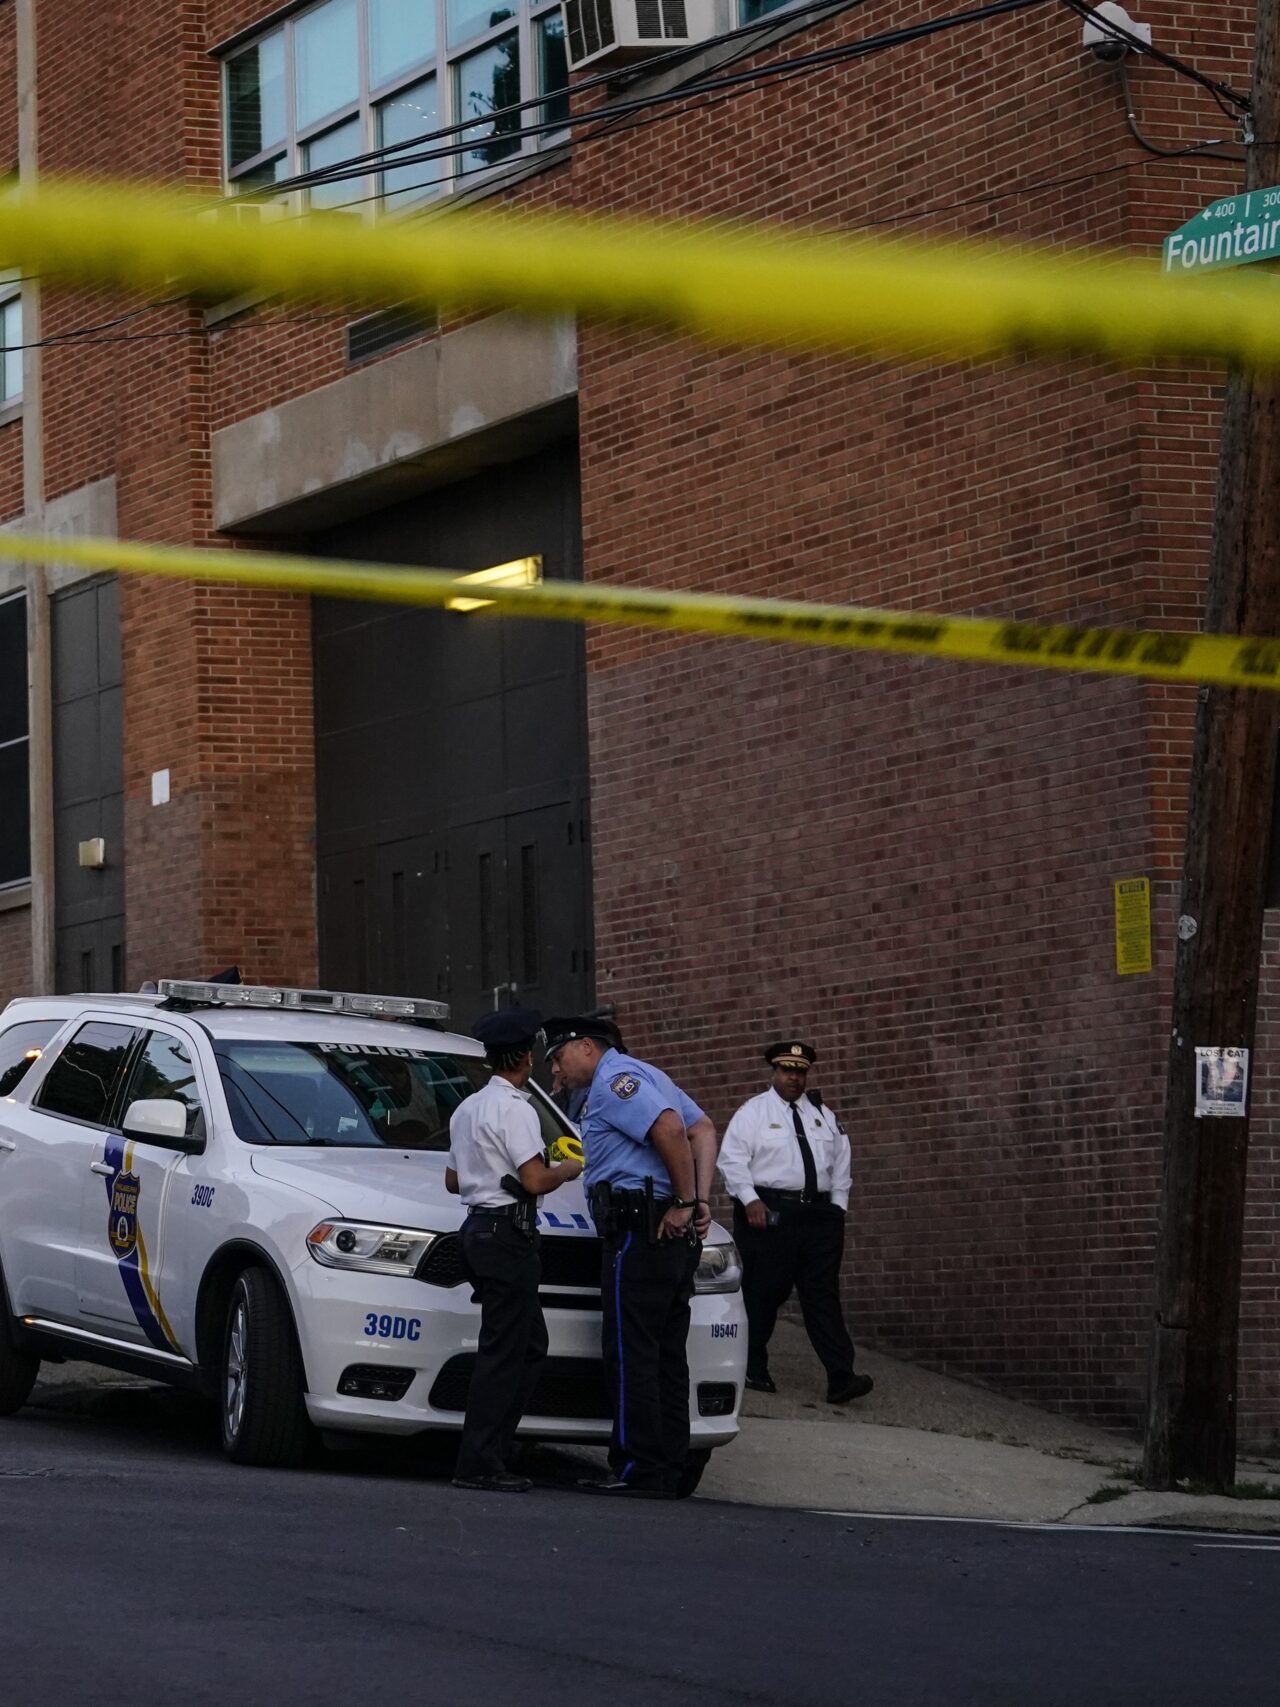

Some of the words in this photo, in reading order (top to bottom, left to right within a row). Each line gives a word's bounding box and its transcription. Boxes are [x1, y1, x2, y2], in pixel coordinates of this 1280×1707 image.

[1214, 202, 1236, 218] 400
[317, 1043, 430, 1060] POLICE
[1200, 1049, 1225, 1058] LOST
[1227, 1049, 1245, 1058] CAT
[114, 1191, 137, 1215] POLICE
[191, 1183, 215, 1208] 39DC
[364, 1313, 422, 1342] 39DC
[711, 1323, 738, 1339] 195447
